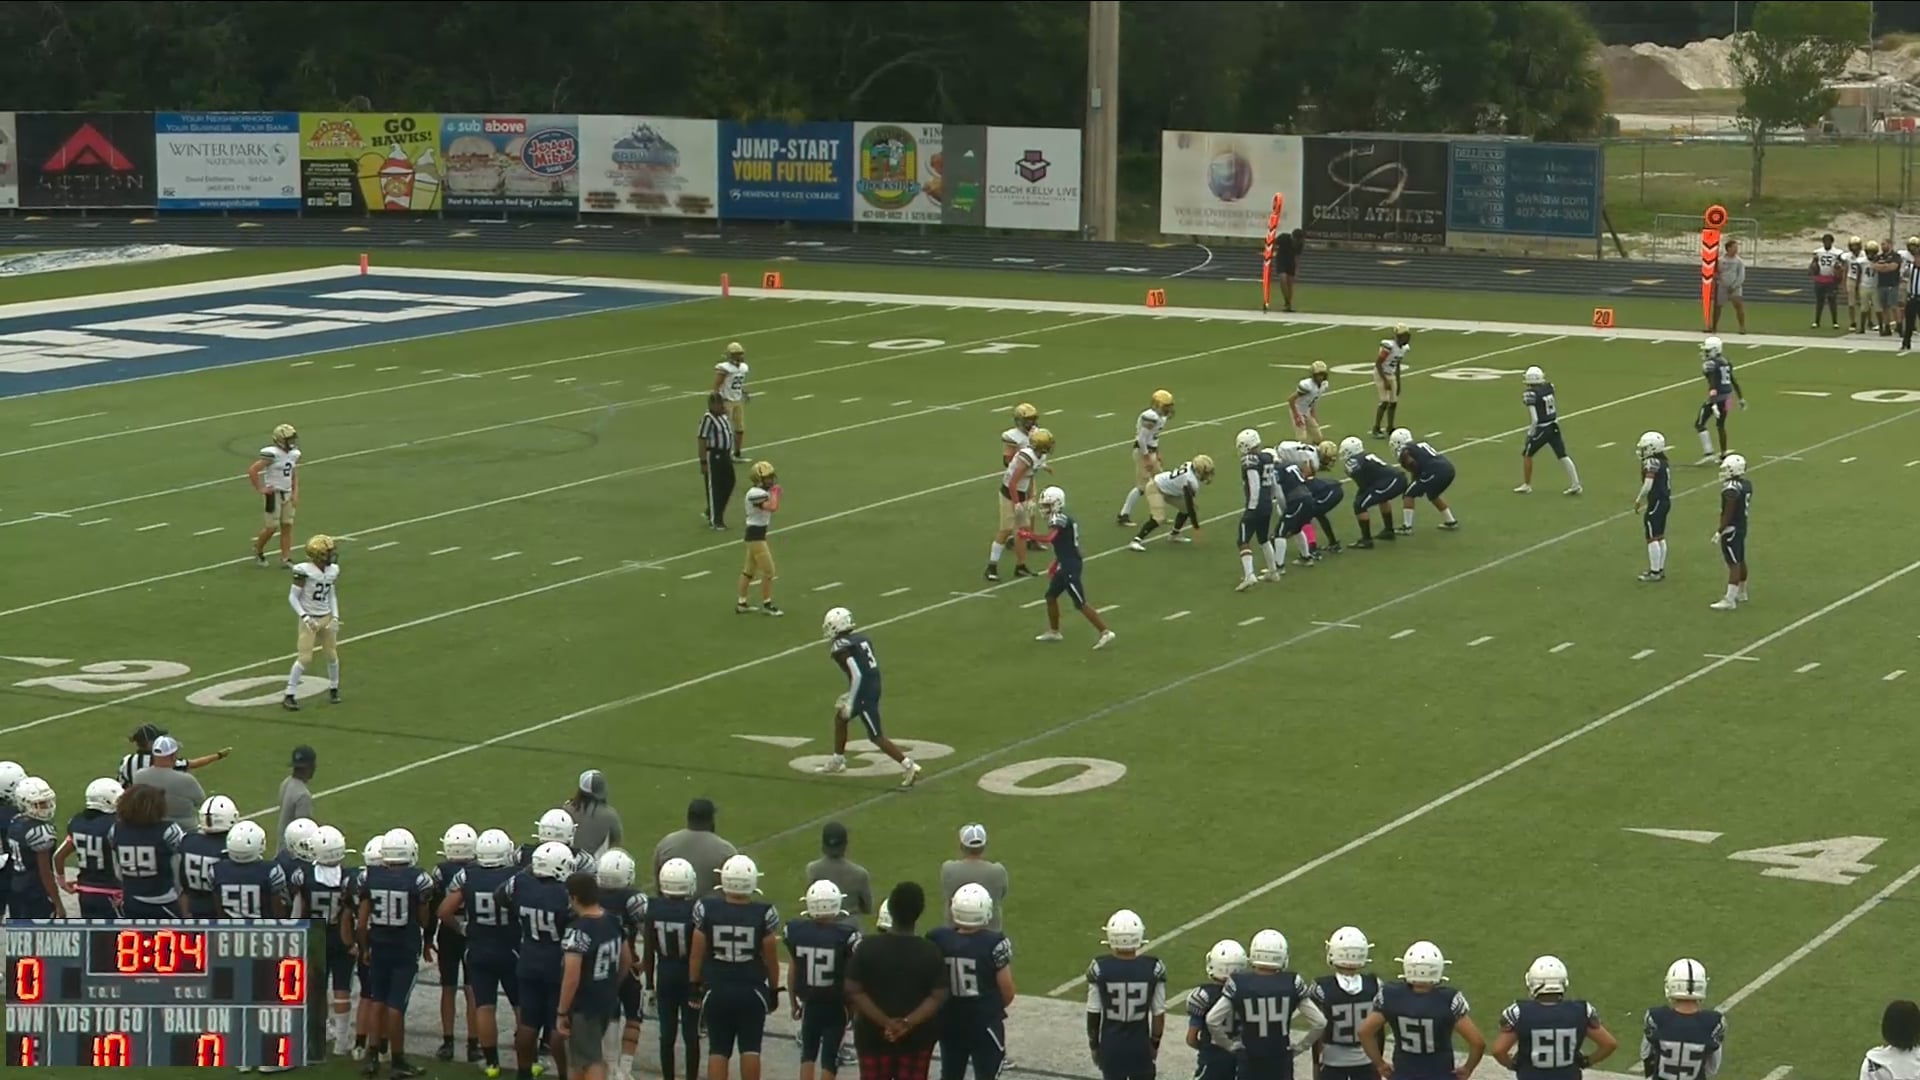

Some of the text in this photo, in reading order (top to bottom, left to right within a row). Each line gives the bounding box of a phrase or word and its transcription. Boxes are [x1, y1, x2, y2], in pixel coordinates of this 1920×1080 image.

[371, 130, 432, 147] HAWKS!
[384, 117, 416, 134] GO
[457, 119, 481, 132] sub
[484, 120, 525, 133] above
[168, 142, 268, 157] WINTER PARK
[731, 138, 840, 160] JUMP-START
[732, 160, 838, 183] YOUR FUTURE.
[782, 190, 804, 199] STATE
[805, 191, 840, 200] COLLEGE
[988, 184, 1078, 197] COACH KELLY LIVE
[1313, 205, 1359, 220] CLASS
[1149, 291, 1163, 306] 10
[1594, 310, 1611, 325] 20
[860, 641, 877, 669] 3
[72, 832, 104, 870] 54
[117, 846, 157, 878] 99
[221, 883, 262, 918] 50
[370, 889, 409, 926] 30
[520, 906, 560, 942] 74
[712, 925, 755, 963] 52
[796, 945, 835, 987] 72
[1105, 982, 1148, 1022] 32
[1243, 996, 1290, 1038] 44
[1397, 1016, 1435, 1053] 51
[1531, 1028, 1577, 1068] 60
[1659, 1039, 1705, 1080] 25
